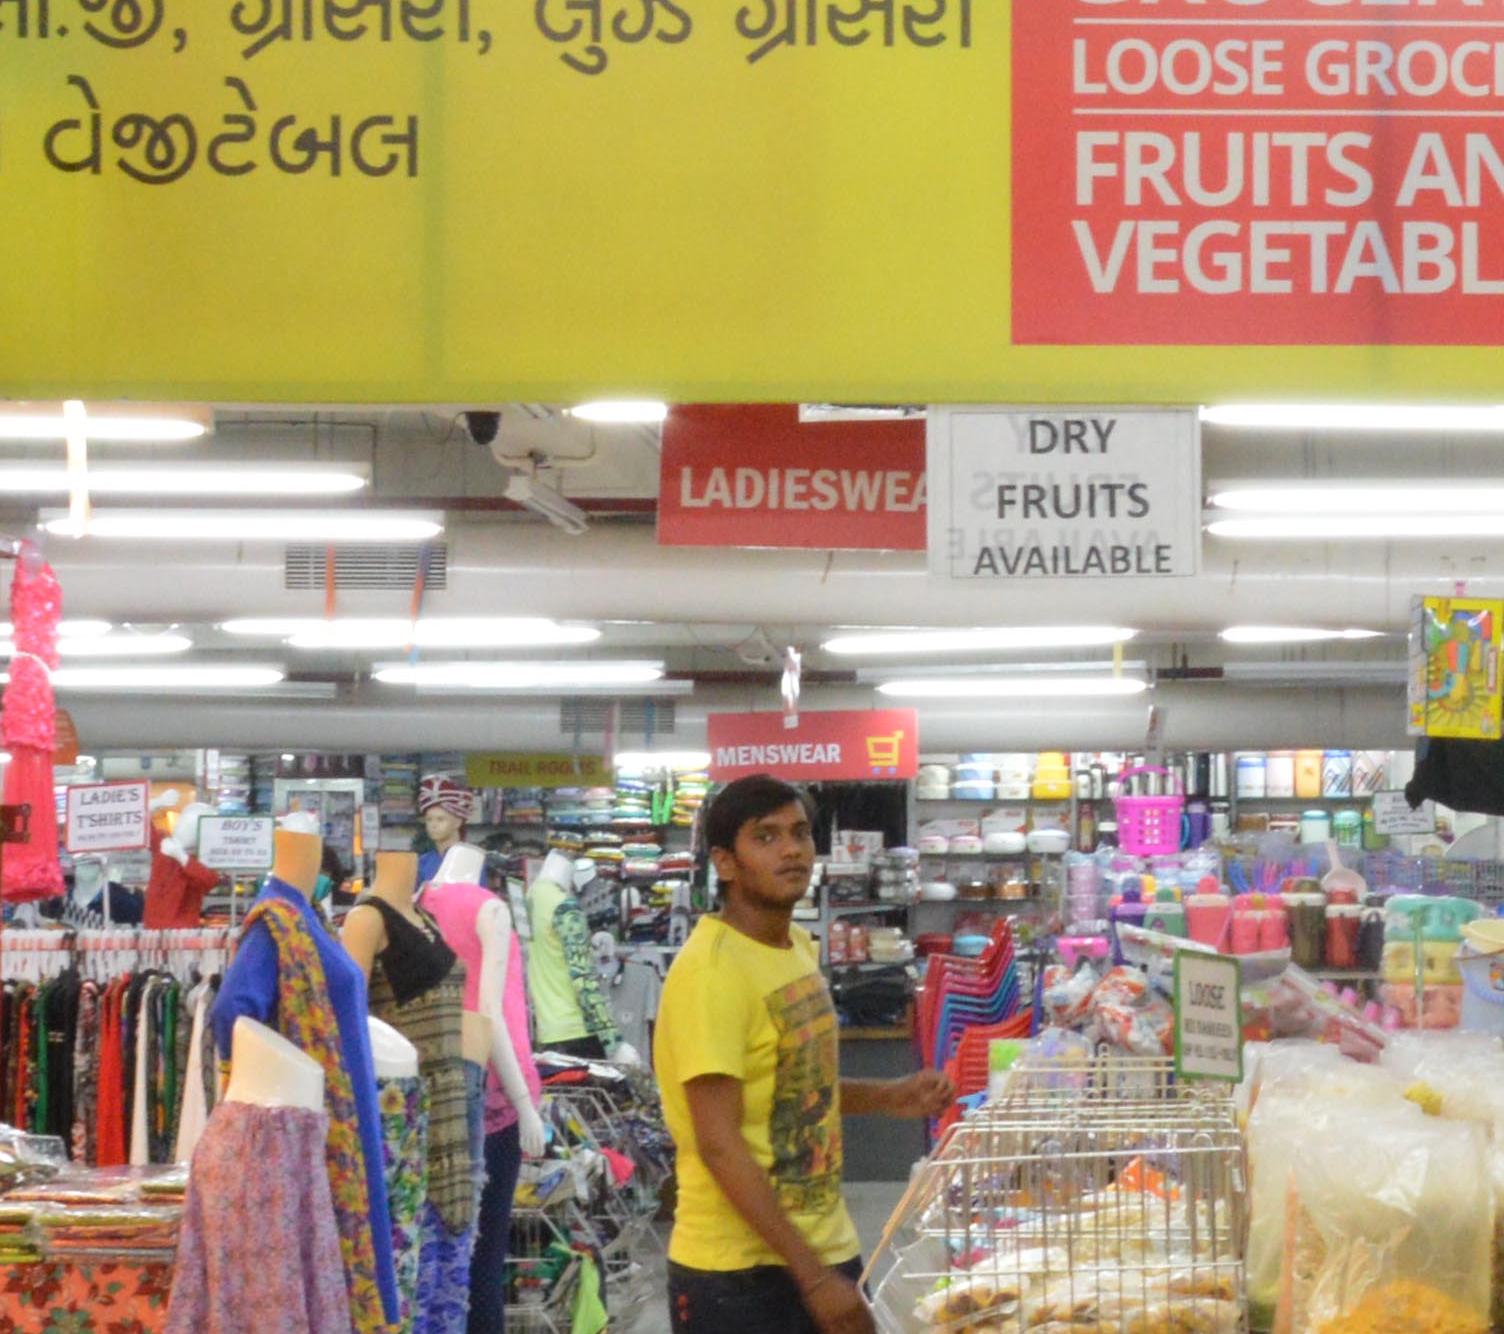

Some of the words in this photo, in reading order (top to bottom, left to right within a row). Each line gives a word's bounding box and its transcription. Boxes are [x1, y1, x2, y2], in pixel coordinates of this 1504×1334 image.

[1072, 38, 1284, 97] LOOSE
[44, 74, 414, 185] વેજીટેબલ
[1074, 130, 1373, 209] FRUITS
[1027, 418, 1116, 456] DRY
[679, 469, 927, 514] LADIESWEA
[996, 482, 1151, 522] FRUITS
[973, 540, 1173, 578] AVAILABLE
[717, 741, 841, 768] MENSWEAR
[80, 789, 140, 806] LADIE'S
[220, 819, 263, 832] BOY'S
[1189, 981, 1225, 1009] LOOSE
